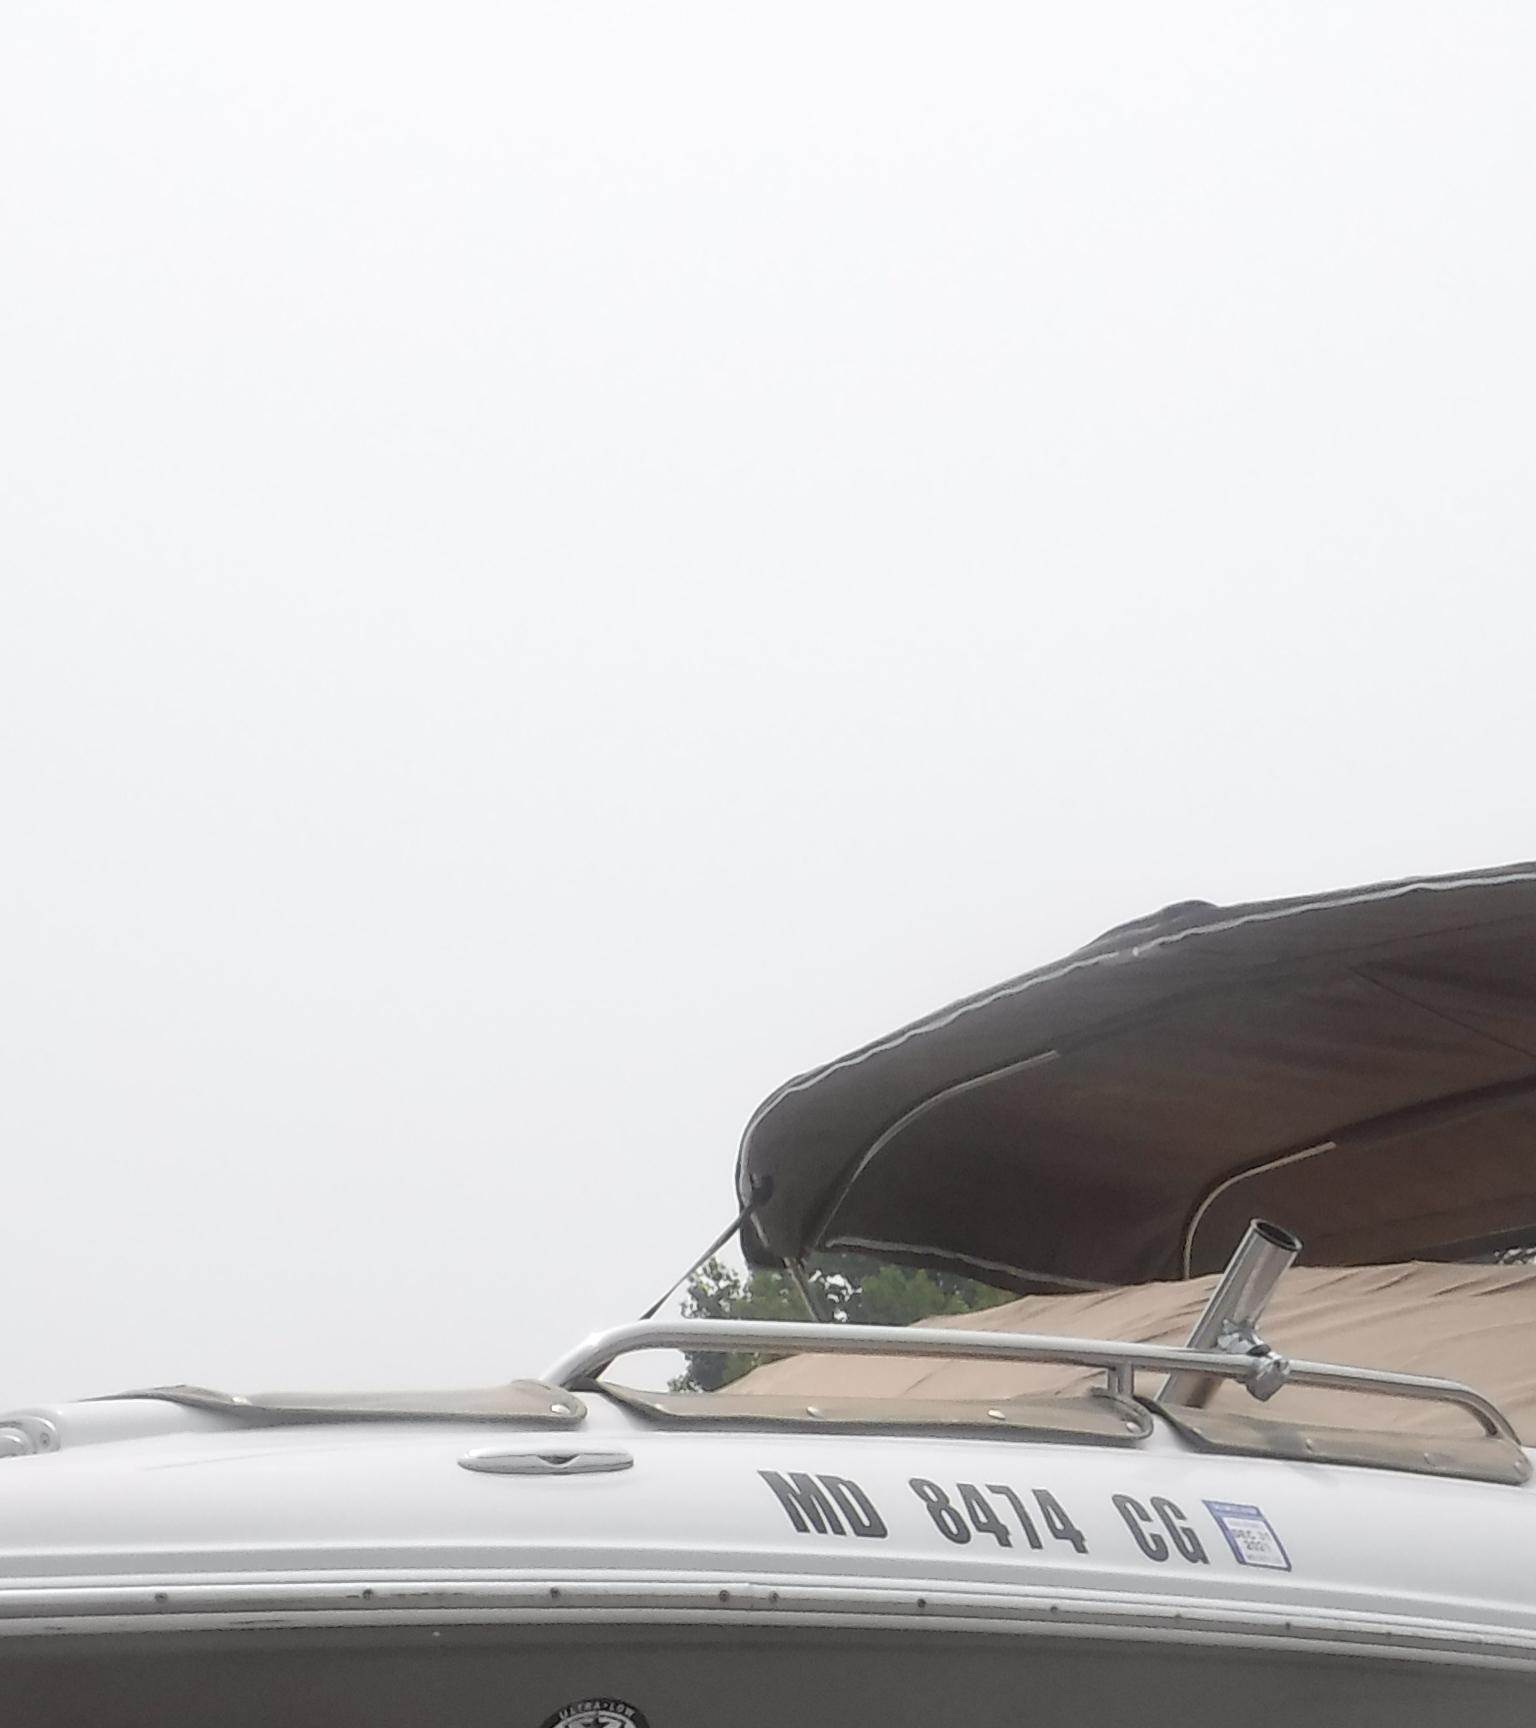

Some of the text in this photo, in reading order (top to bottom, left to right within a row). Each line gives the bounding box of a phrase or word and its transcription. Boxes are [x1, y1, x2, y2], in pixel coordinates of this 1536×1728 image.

[758, 1470, 1209, 1564] MD 8474 CG
